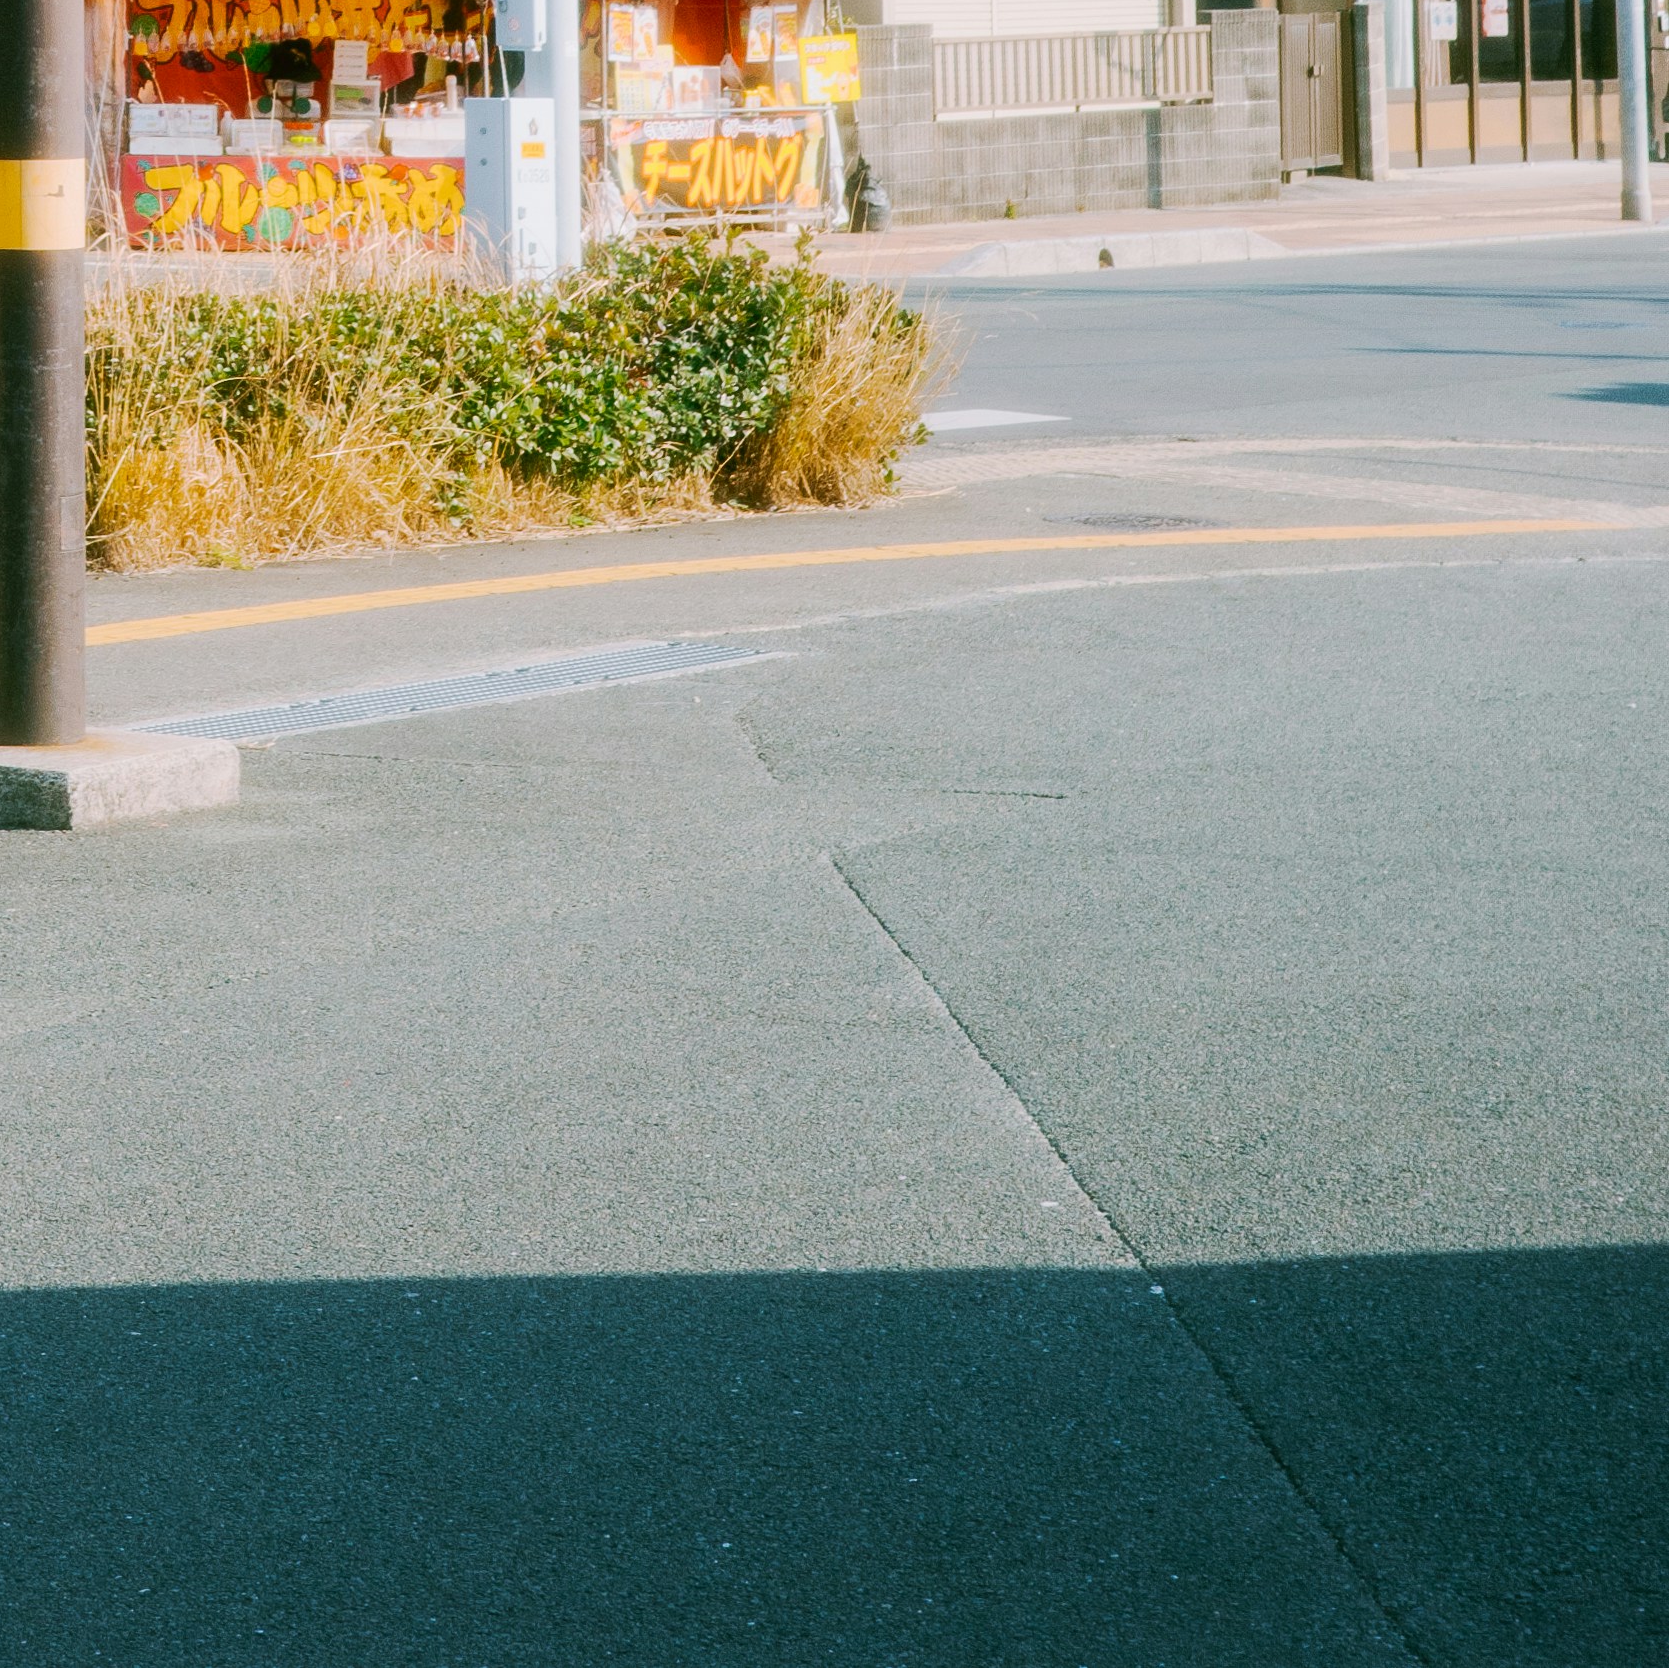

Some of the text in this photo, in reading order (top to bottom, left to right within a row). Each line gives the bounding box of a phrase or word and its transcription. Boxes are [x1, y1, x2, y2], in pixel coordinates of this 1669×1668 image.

[641, 131, 803, 208] チーズハットグ
